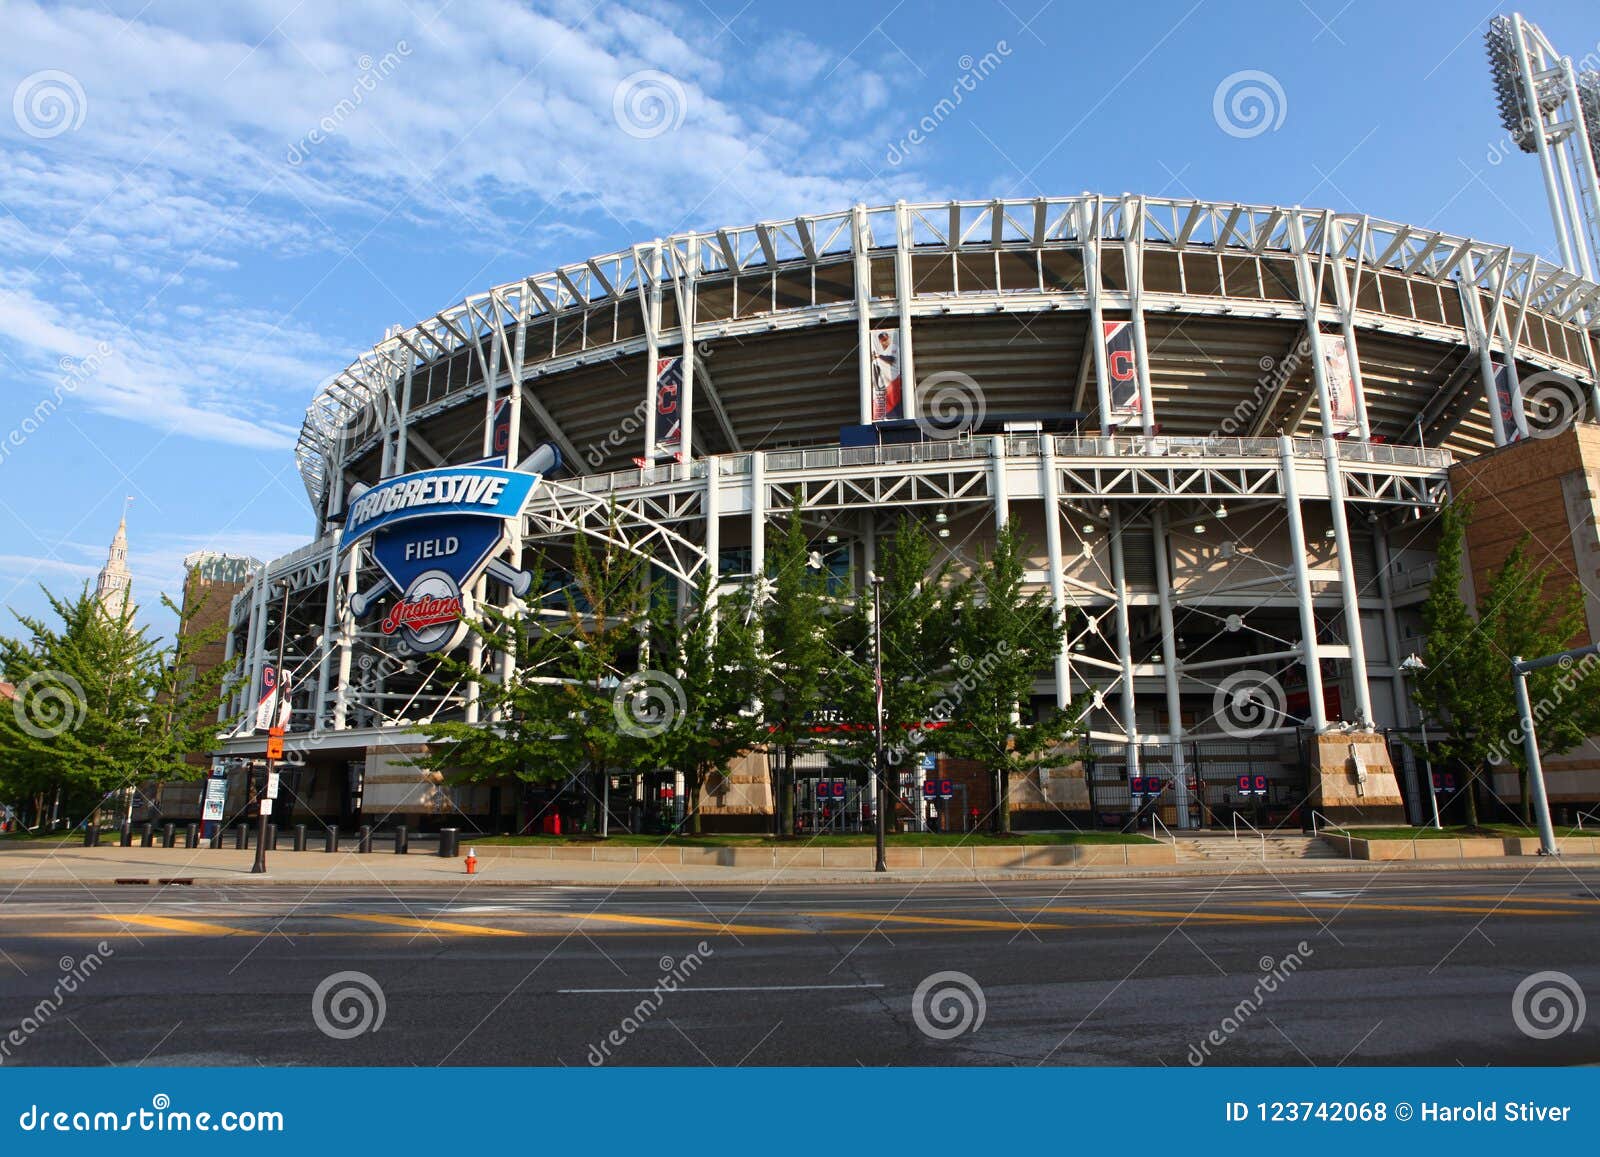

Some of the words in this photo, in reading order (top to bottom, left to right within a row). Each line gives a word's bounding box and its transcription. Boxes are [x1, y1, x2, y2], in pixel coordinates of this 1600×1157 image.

[1110, 350, 1135, 381] C
[657, 384, 678, 415] C
[349, 475, 509, 532] PROGRESSIVE
[405, 536, 459, 561] FIELD
[381, 593, 463, 635] Indians
[264, 667, 275, 687] C
[1240, 776, 1250, 789] C
[1254, 775, 1265, 789] C
